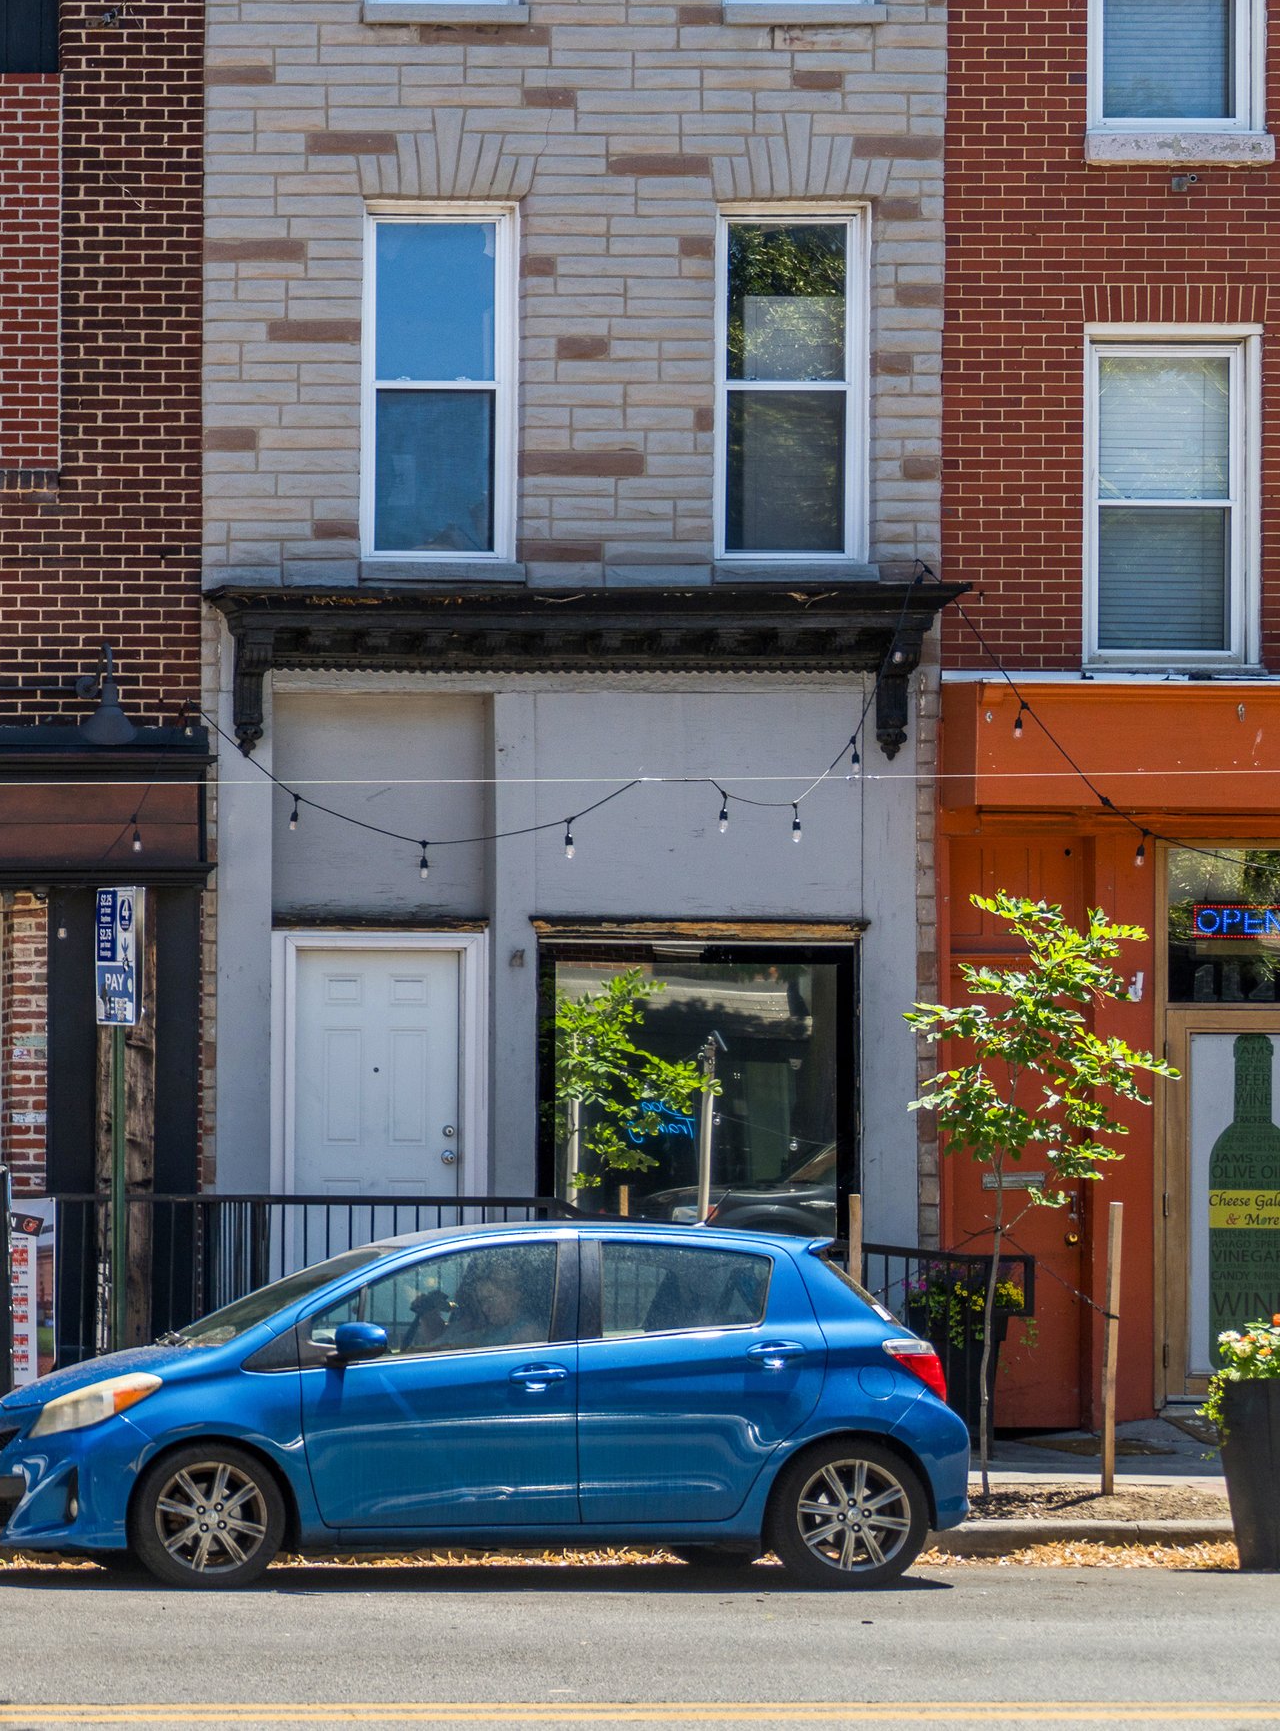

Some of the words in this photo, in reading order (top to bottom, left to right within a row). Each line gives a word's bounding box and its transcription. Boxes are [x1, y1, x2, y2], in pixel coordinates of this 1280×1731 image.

[122, 898, 130, 919] 4
[1197, 909, 1280, 933] OPEN
[105, 973, 125, 991] PAY
[1235, 1073, 1271, 1086] BEER
[1235, 1093, 1272, 1105] WINE
[1213, 1152, 1253, 1164] JAMS
[1211, 1165, 1256, 1179] OLIVE
[1209, 1191, 1250, 1207] Cheese
[1226, 1213, 1240, 1226] &
[1244, 1213, 1279, 1226] More
[1211, 1270, 1249, 1280] CANDY
